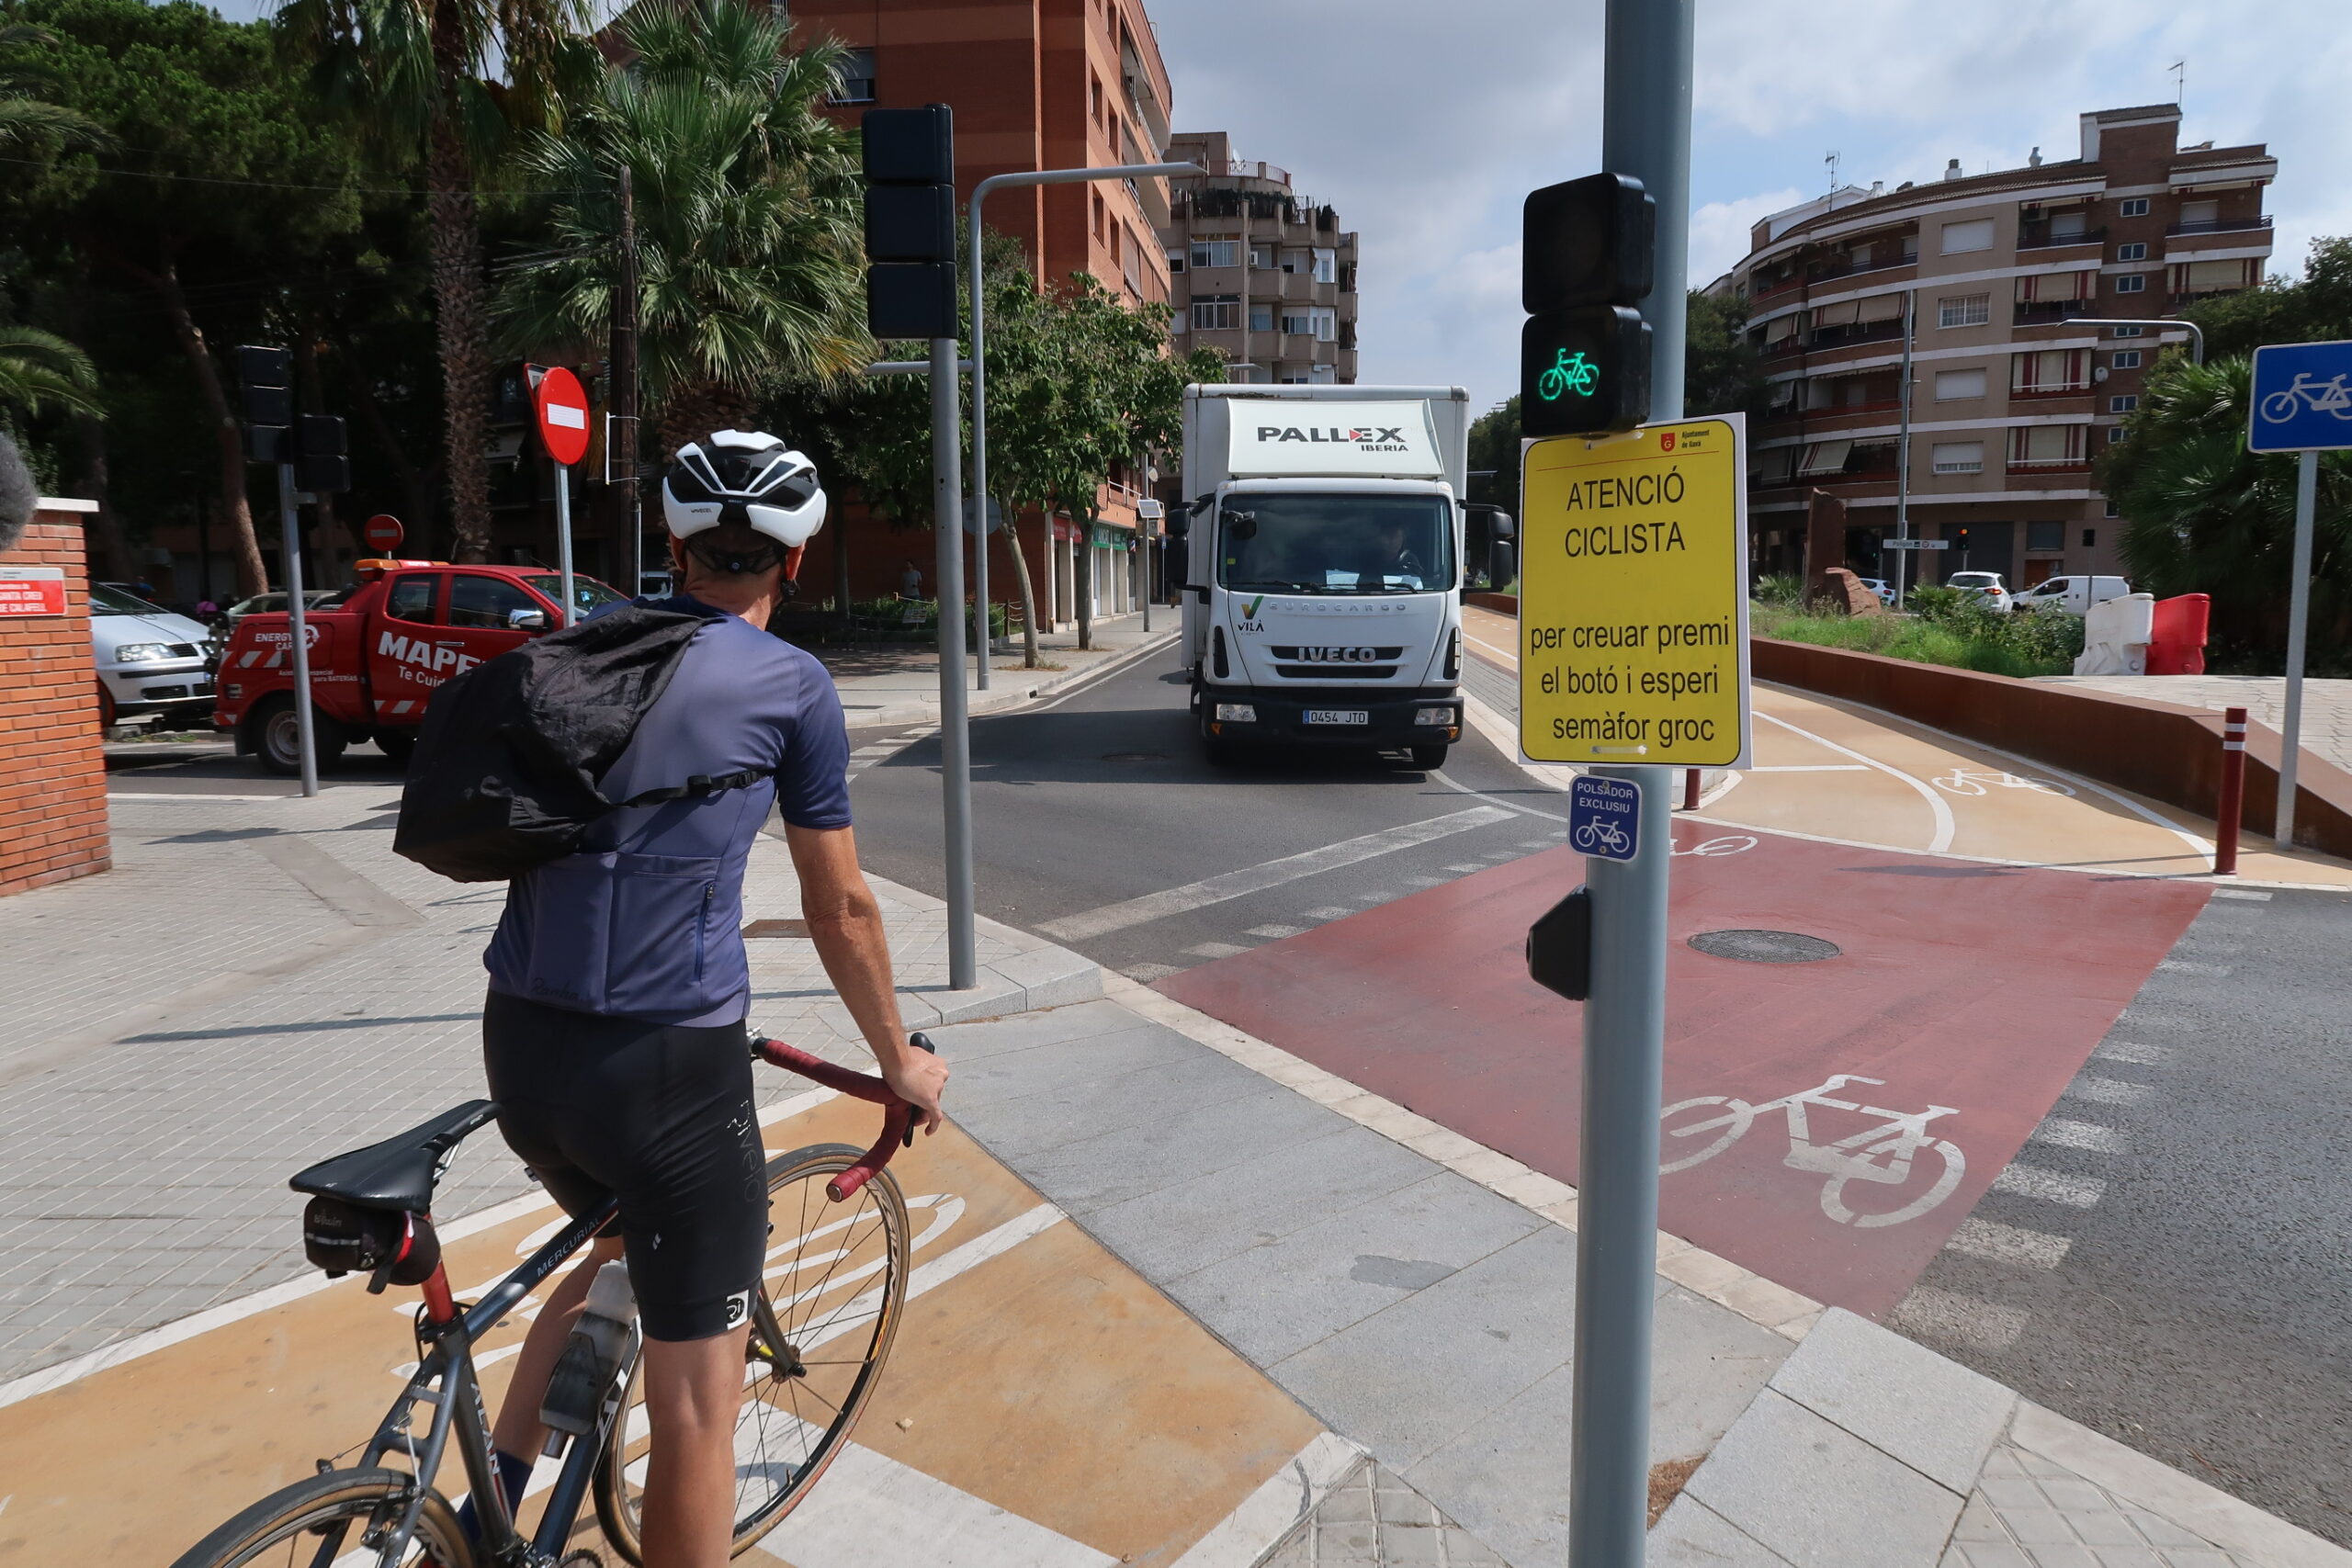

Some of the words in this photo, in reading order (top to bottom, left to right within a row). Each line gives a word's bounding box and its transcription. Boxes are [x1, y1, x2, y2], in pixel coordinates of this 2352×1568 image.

[1257, 426, 1406, 443] PALLEX
[1682, 429, 1710, 440] Ajuntament
[1566, 465, 1685, 512] ATENCIÓ
[1565, 521, 1686, 558] CICLISTA
[1269, 602, 1407, 613] EUROCARGO
[1531, 627, 1566, 656] per
[1573, 625, 1649, 649] creuar
[1657, 615, 1729, 654] premi
[378, 631, 486, 676] MAPF
[1297, 647, 1376, 662] IVECO
[398, 665, 413, 681] Te
[1541, 665, 1559, 694] el
[1567, 665, 1619, 694] botó
[1626, 665, 1632, 694] i
[1640, 664, 1718, 701] esperi
[1311, 712, 1338, 723] 0454
[1345, 712, 1366, 723] JTD
[1553, 711, 1651, 740] semàfor
[1658, 718, 1715, 749] groc
[1577, 783, 1634, 800] POLSADOR
[1578, 797, 1631, 814] EXCLUSIU
[536, 1217, 602, 1278] MERCURIAL
[469, 1382, 501, 1475] ALAN
